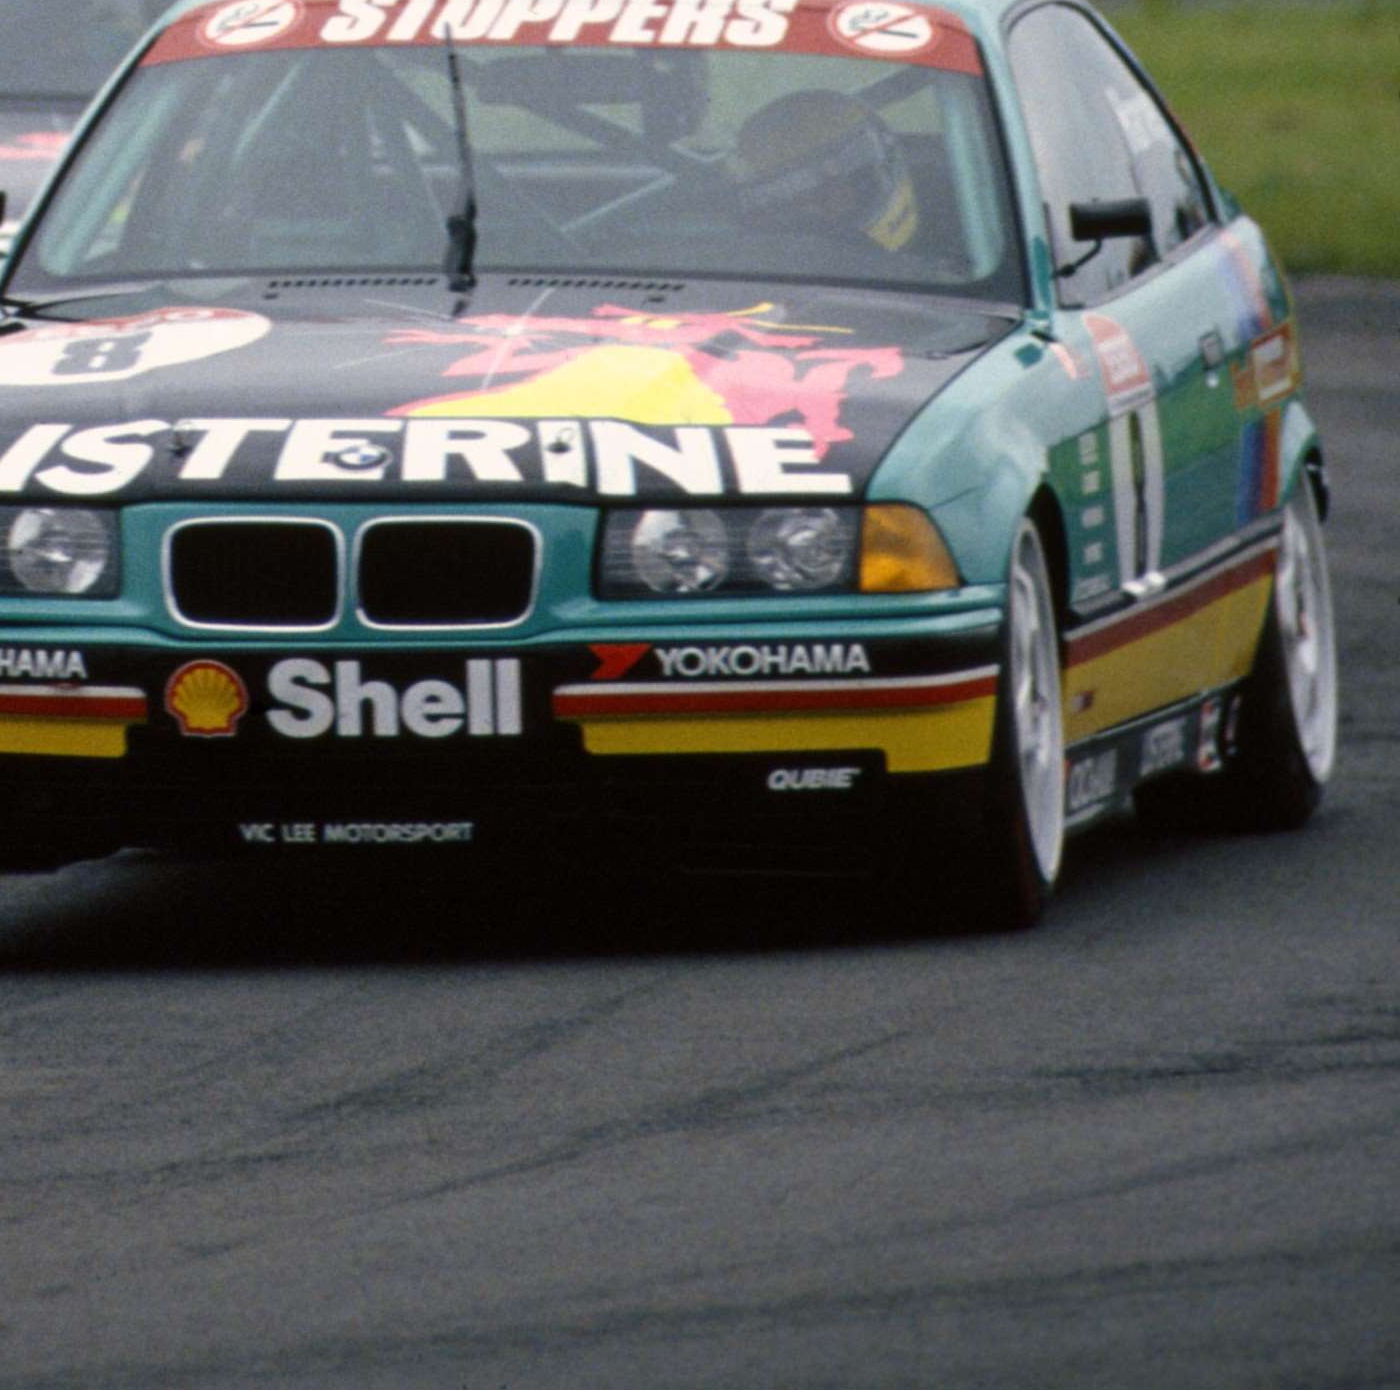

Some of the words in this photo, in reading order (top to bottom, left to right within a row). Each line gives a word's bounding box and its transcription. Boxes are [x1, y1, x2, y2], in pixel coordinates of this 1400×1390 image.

[52, 331, 153, 375] 8
[654, 643, 871, 677] YOKOHAMA
[266, 657, 522, 738] Shell
[239, 823, 275, 842] VIC
[282, 823, 315, 842] LEE
[324, 822, 473, 842] MOTORSPORT
